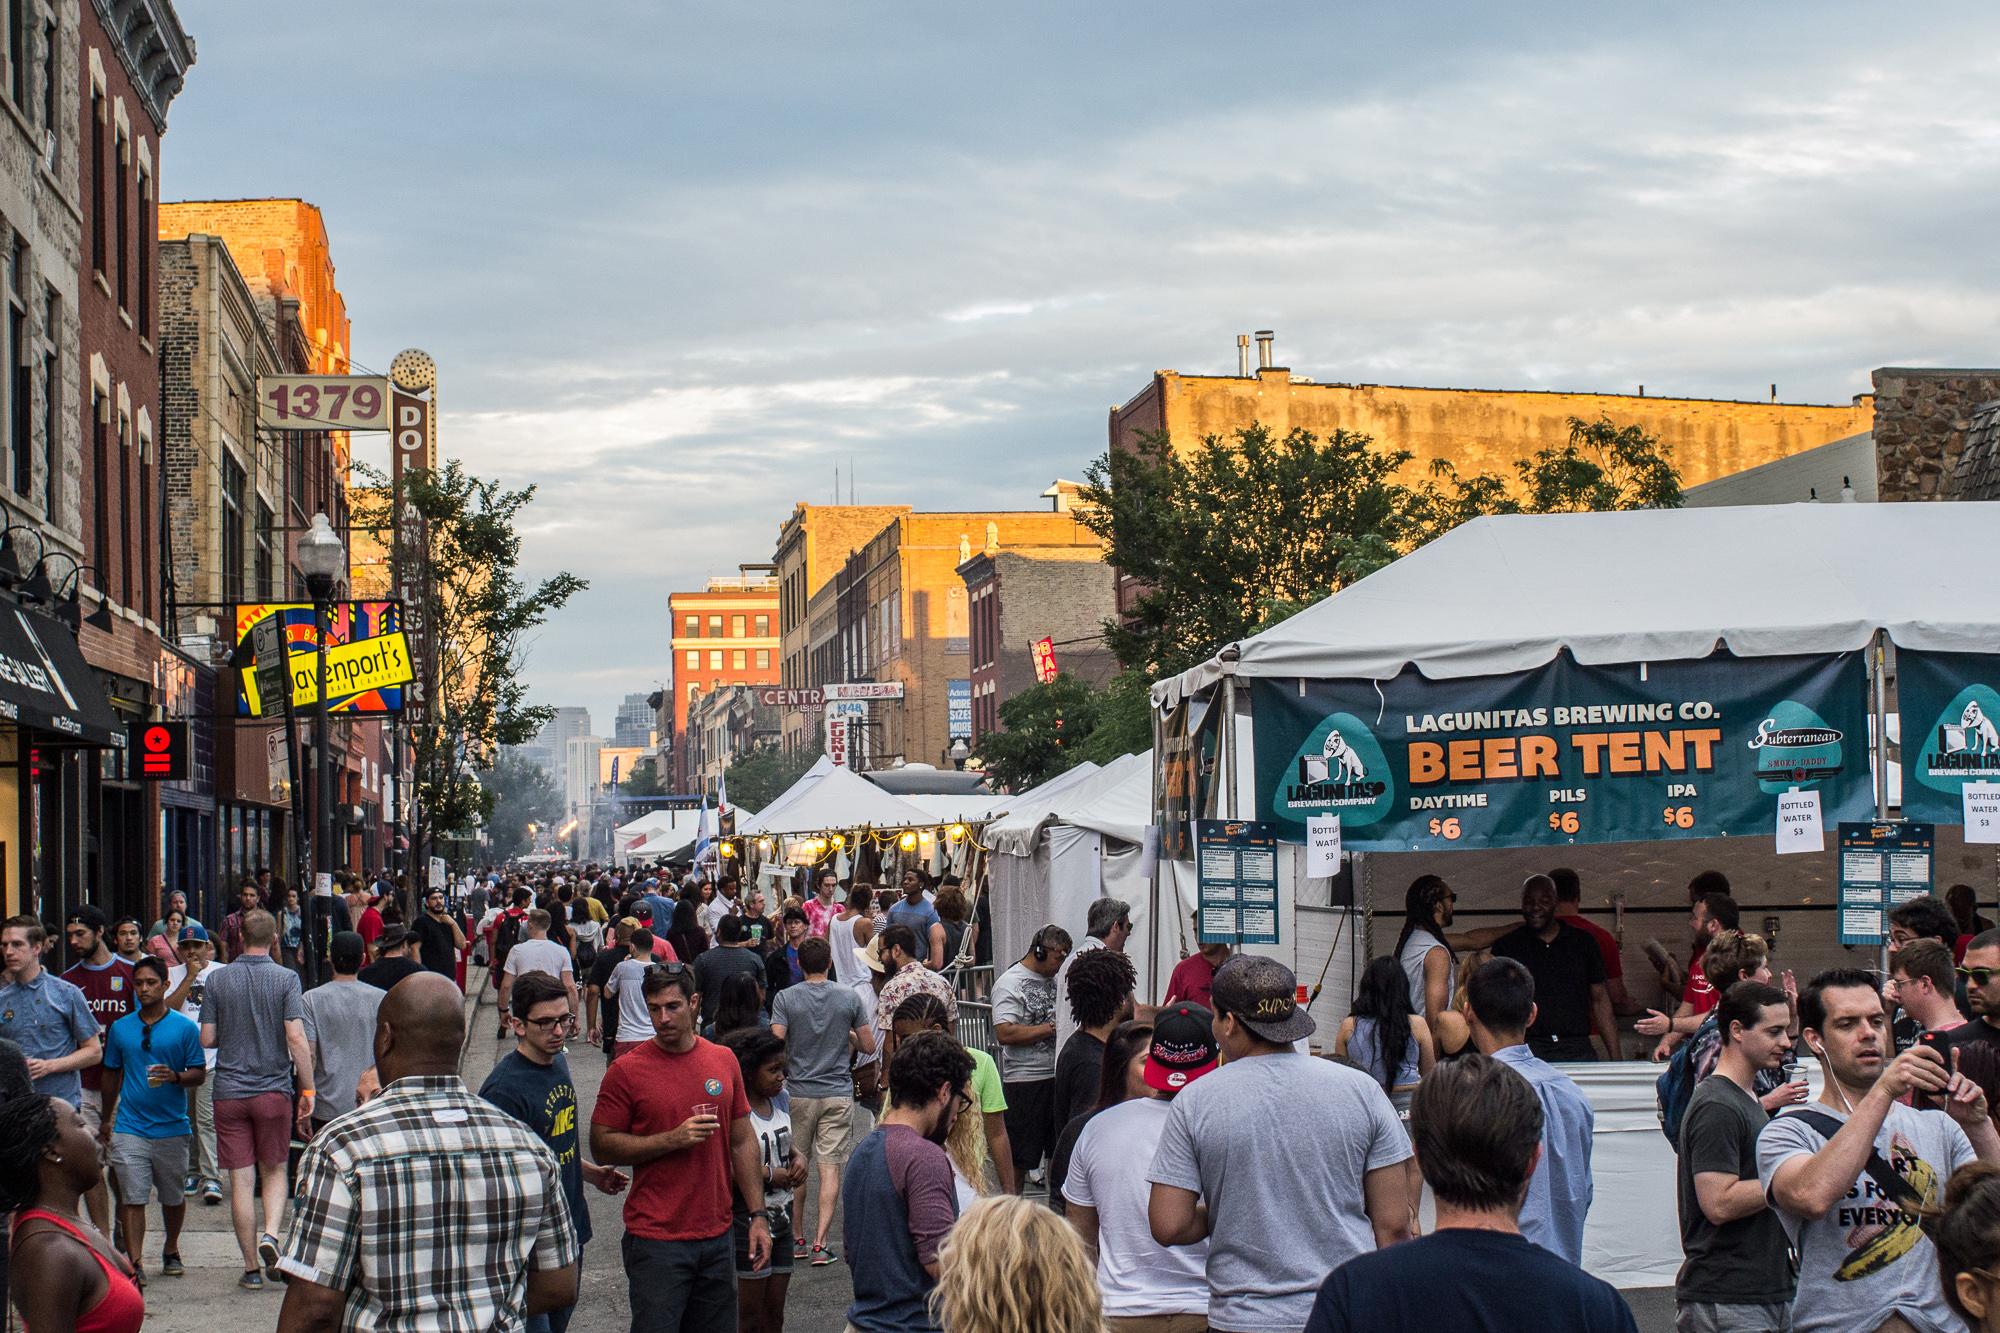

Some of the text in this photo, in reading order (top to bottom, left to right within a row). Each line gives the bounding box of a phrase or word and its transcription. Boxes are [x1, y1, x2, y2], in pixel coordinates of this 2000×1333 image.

[268, 384, 382, 420] 1379
[6, 656, 55, 694] GALLERY
[949, 699, 971, 708] MORE
[1405, 701, 1721, 733] LAGUNITAS BREWING CO.
[949, 722, 971, 732] MORE
[1748, 718, 1836, 749] Subterranean
[1407, 728, 1722, 786] BEER TENT
[1287, 783, 1375, 801] LAGUNITAS
[1549, 788, 1587, 803] PILS
[1667, 783, 1697, 798] IPA
[1287, 797, 1376, 808] BREWING COMPANY
[1410, 793, 1488, 810] DAYTIME
[1780, 801, 1814, 810] BOTTLED
[1549, 811, 1580, 834] $6
[1663, 806, 1695, 828] $6
[1783, 814, 1812, 823] WATER
[1980, 819, 1990, 827] $3
[1429, 817, 1461, 839] $6
[1793, 828, 1804, 836] $3
[1325, 852, 1334, 860] $3
[1164, 1040, 1194, 1050] CHICAGO
[1891, 1155, 1925, 1175] RT.
[1864, 1180, 1889, 1200] FO
